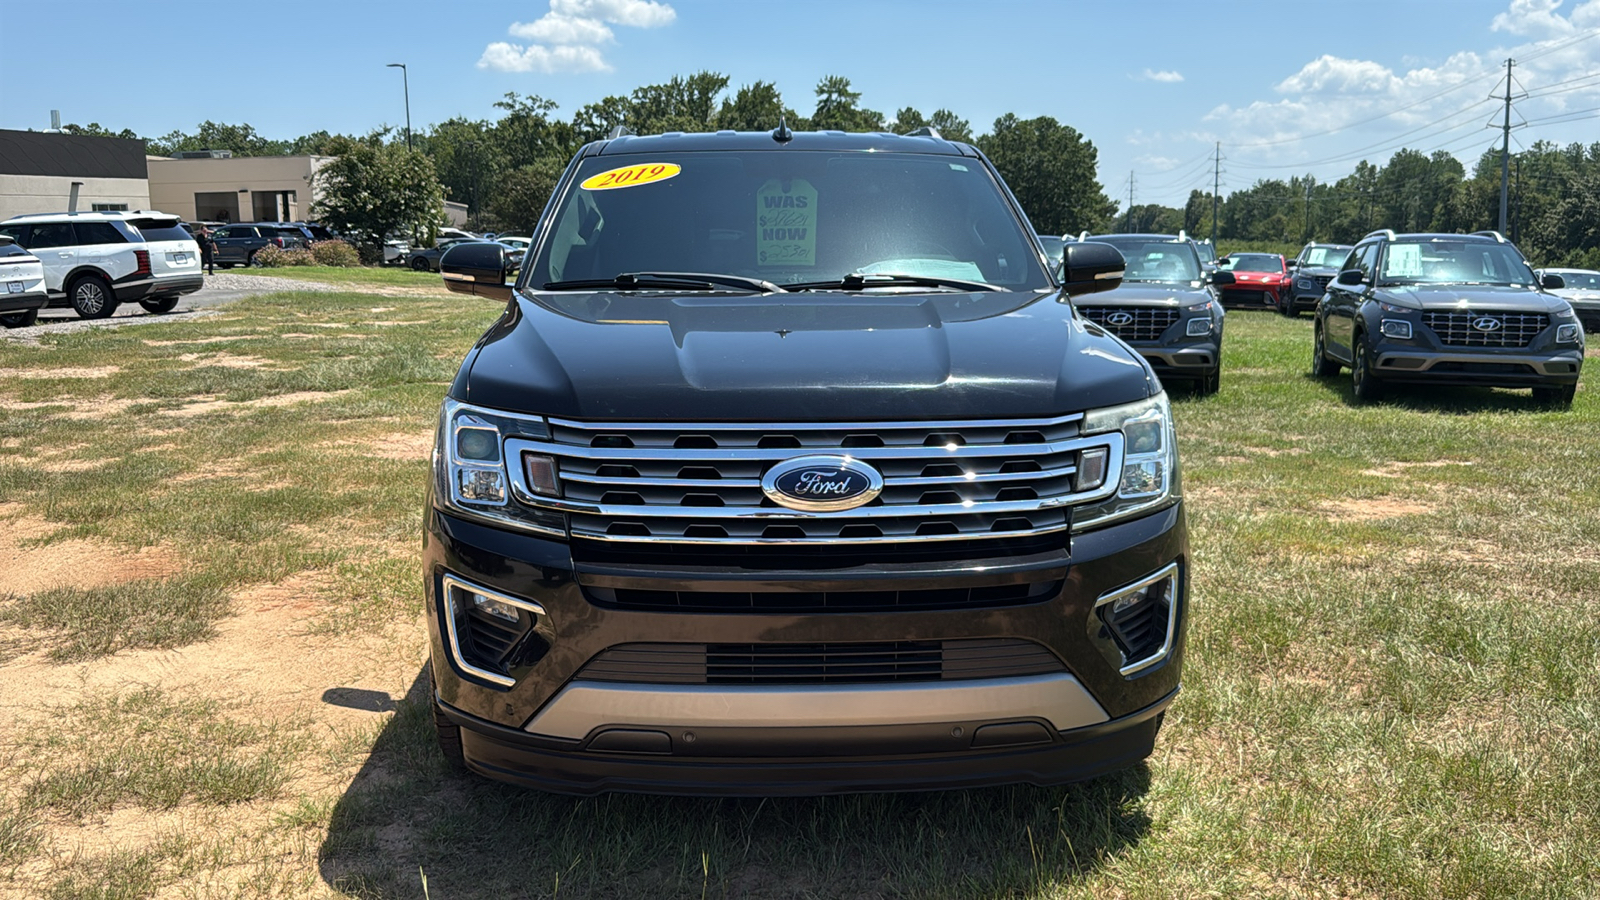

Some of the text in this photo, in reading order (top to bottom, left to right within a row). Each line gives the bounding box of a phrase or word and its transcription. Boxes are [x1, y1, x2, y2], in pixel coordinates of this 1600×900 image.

[597, 165, 665, 187] 2019
[763, 195, 808, 208] WAS
[762, 228, 808, 241] NOW
[794, 470, 852, 495] Ford
